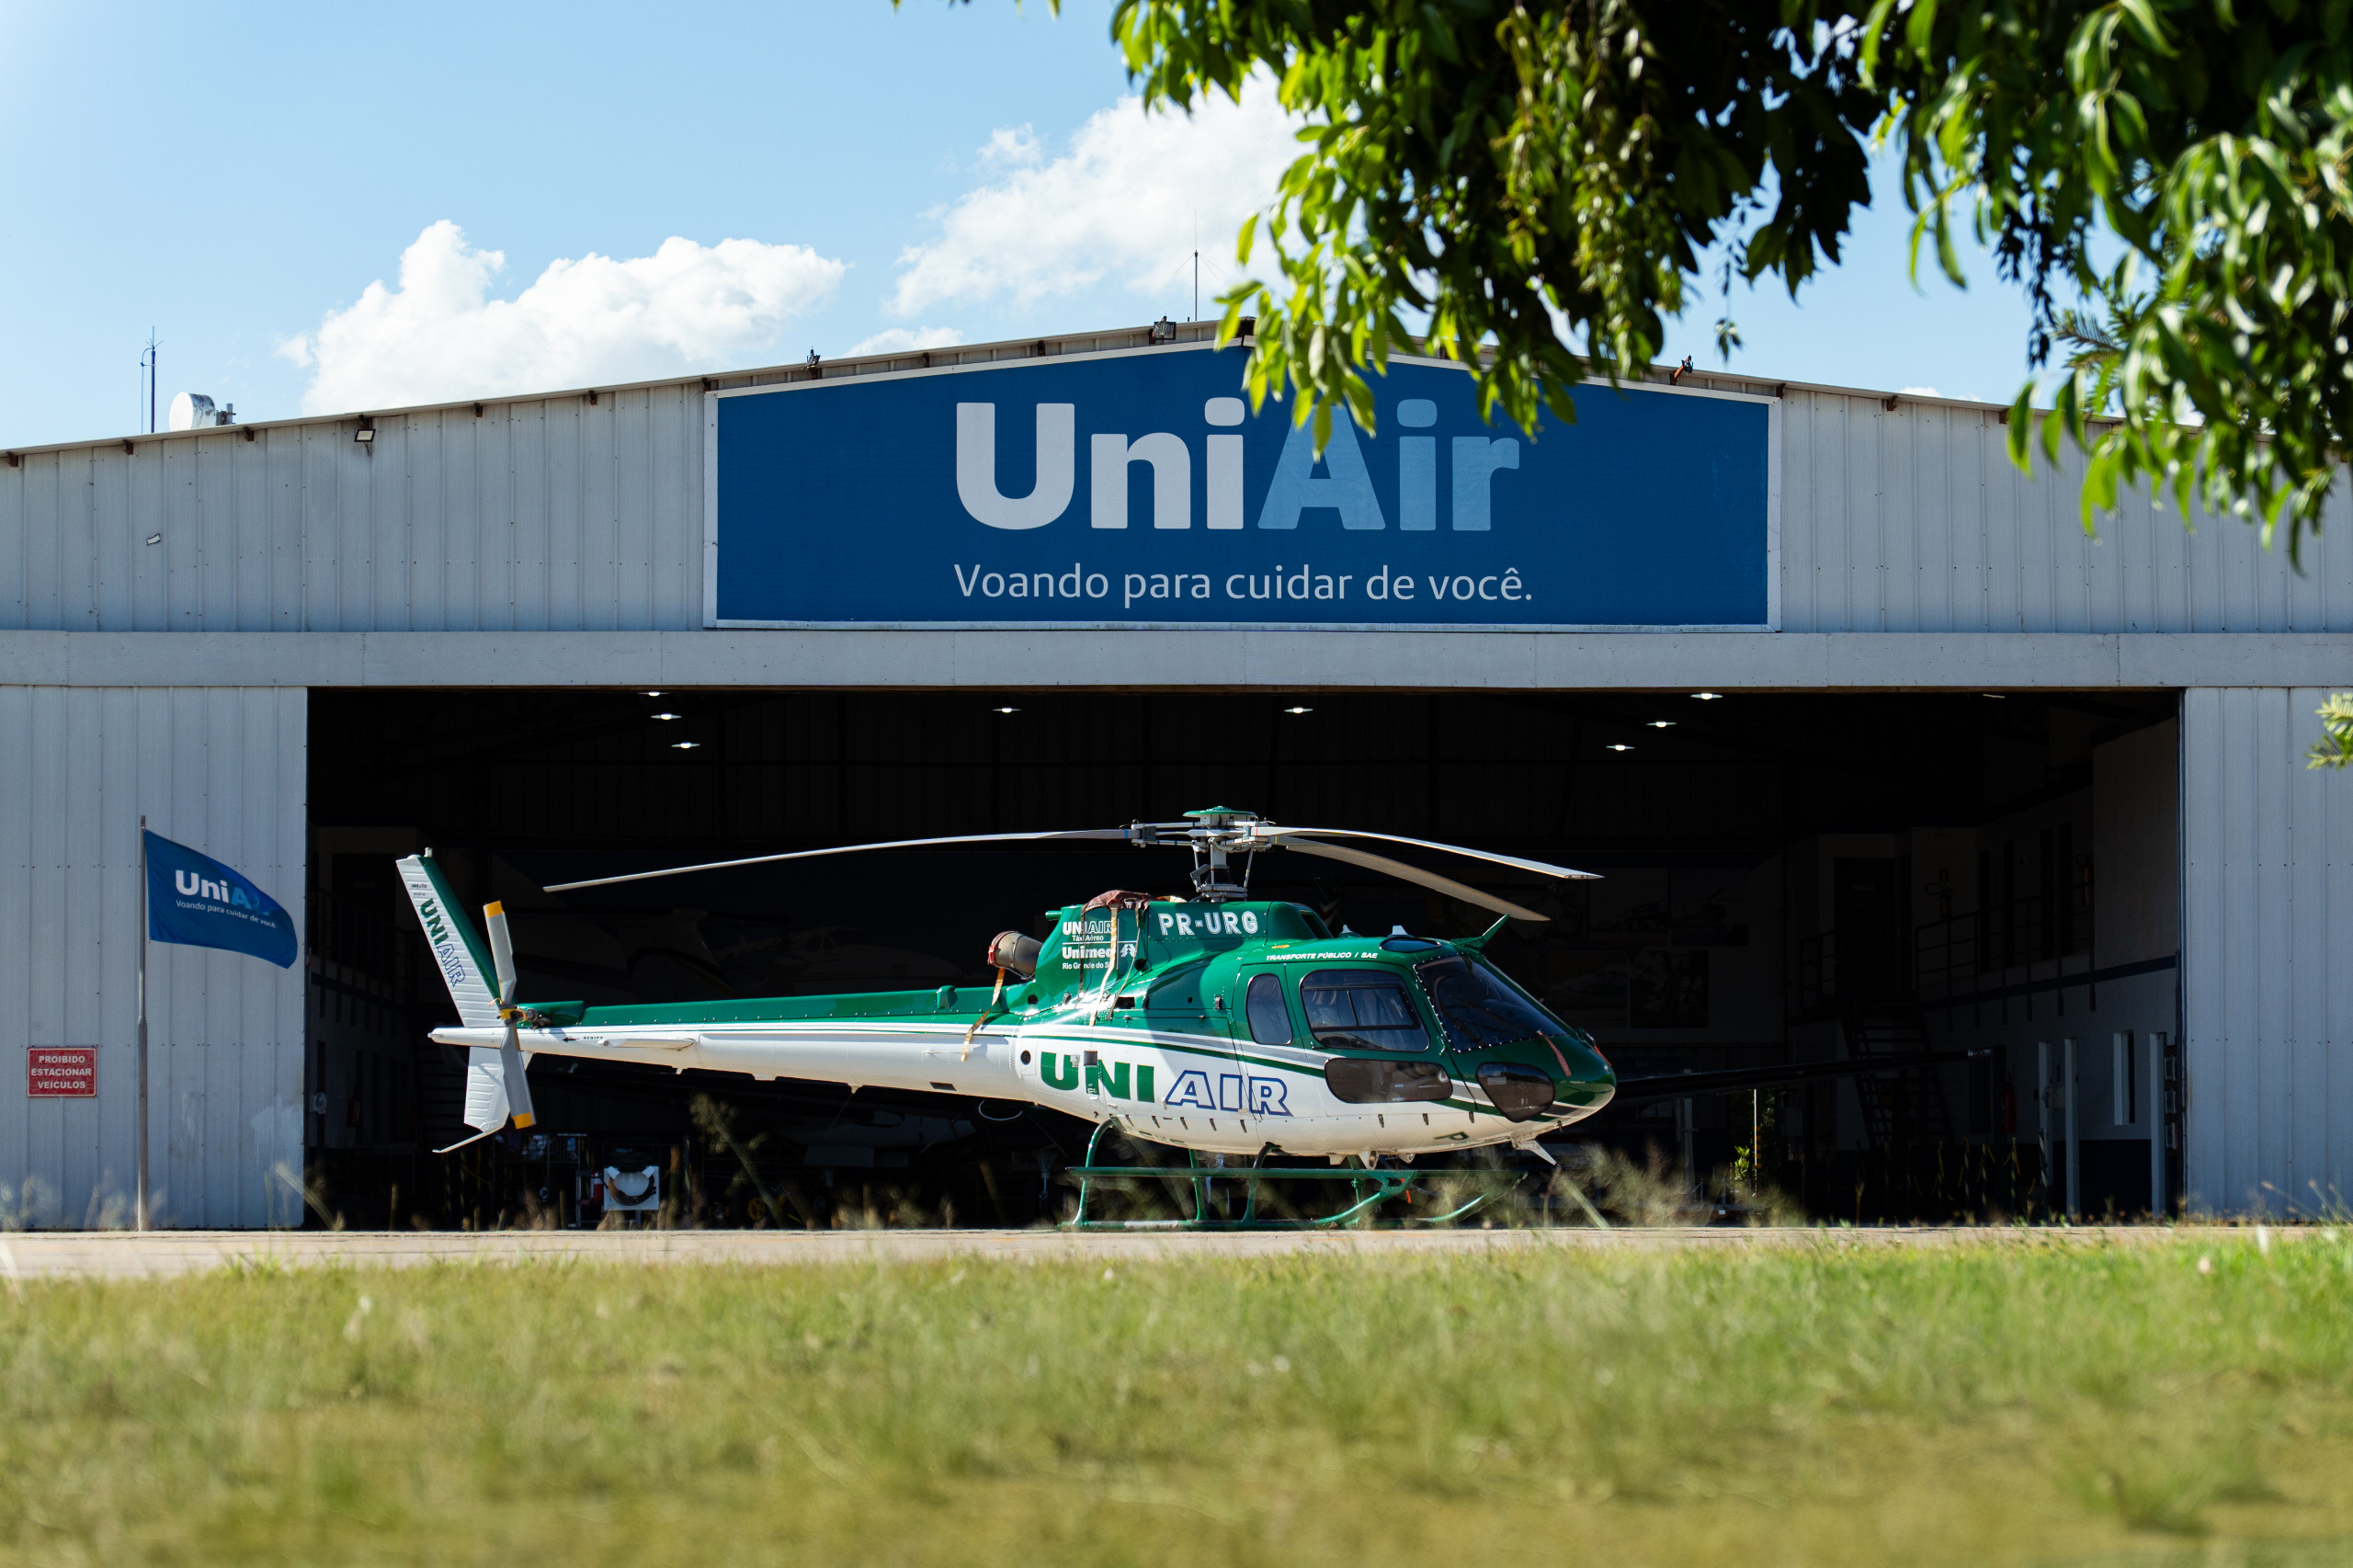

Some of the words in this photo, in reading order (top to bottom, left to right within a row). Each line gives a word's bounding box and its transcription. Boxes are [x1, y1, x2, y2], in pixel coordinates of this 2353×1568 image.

[956, 396, 1520, 530] UniAir
[953, 562, 1108, 598] Voando
[1124, 573, 1211, 609] para
[1225, 563, 1353, 599] cuidar
[1366, 564, 1415, 600] de
[1428, 566, 1532, 600] você.
[176, 900, 206, 911] Voando
[207, 903, 224, 914] para
[226, 907, 248, 920] cuidar
[249, 914, 259, 923] de
[1157, 911, 1259, 937] PR-URG
[1317, 951, 1352, 960] PÚBLICO
[39, 1055, 85, 1063] PROIBIDO
[30, 1068, 92, 1076] ESTACIONAR
[38, 1079, 85, 1089] VEÍCULOS
